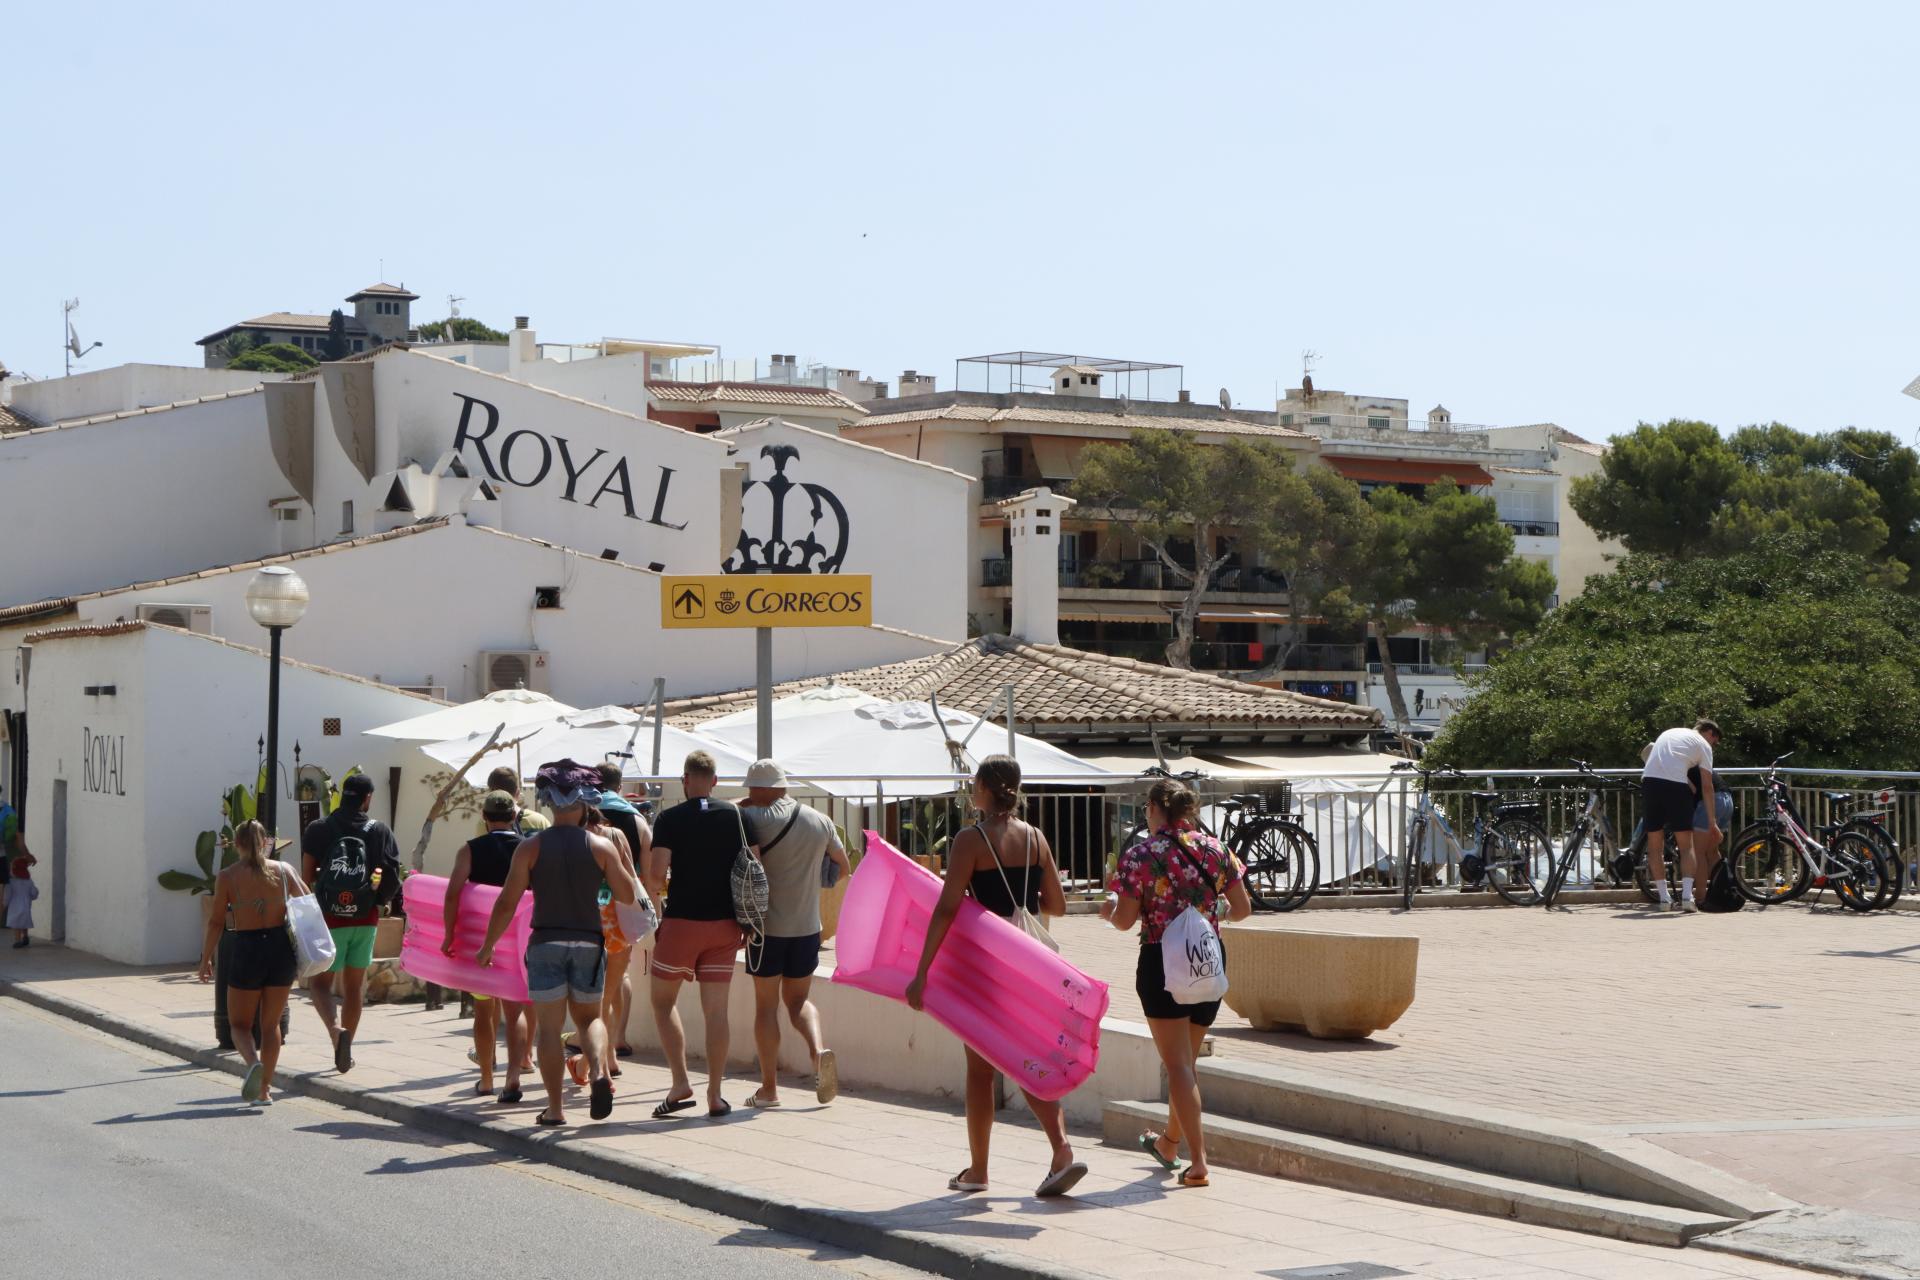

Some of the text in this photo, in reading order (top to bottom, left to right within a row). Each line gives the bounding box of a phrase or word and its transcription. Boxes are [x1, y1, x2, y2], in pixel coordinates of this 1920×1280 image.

[342, 372, 364, 463] ROYAL
[453, 392, 688, 531] ROYAL
[746, 588, 863, 614] CORREOS
[83, 726, 126, 797] ROYAL
